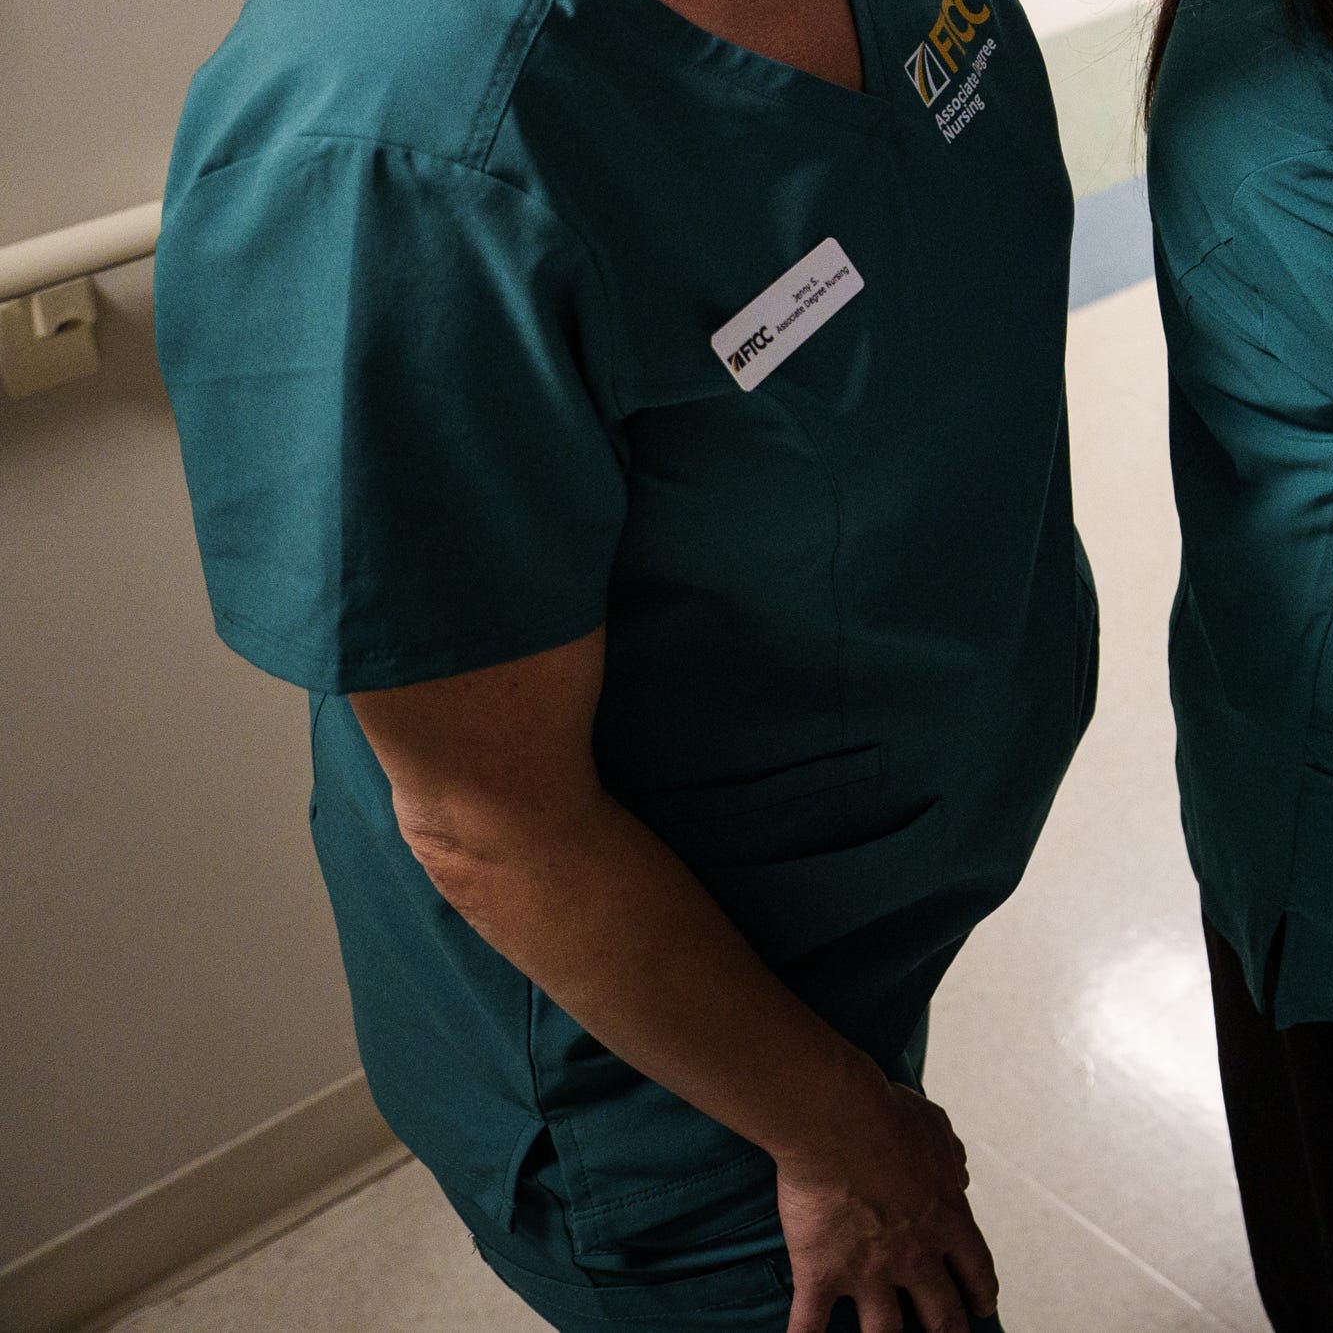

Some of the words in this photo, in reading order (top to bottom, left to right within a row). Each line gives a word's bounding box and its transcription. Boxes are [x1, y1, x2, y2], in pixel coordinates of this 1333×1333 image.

[935, 74, 980, 131] Associate
[972, 38, 997, 77] Degree
[942, 93, 986, 145] Nursing
[776, 306, 806, 334] Associate
[803, 286, 827, 308] Degree
[825, 266, 850, 289] Nursing
[792, 283, 812, 303] Jenny
[740, 325, 774, 363] FTCC
